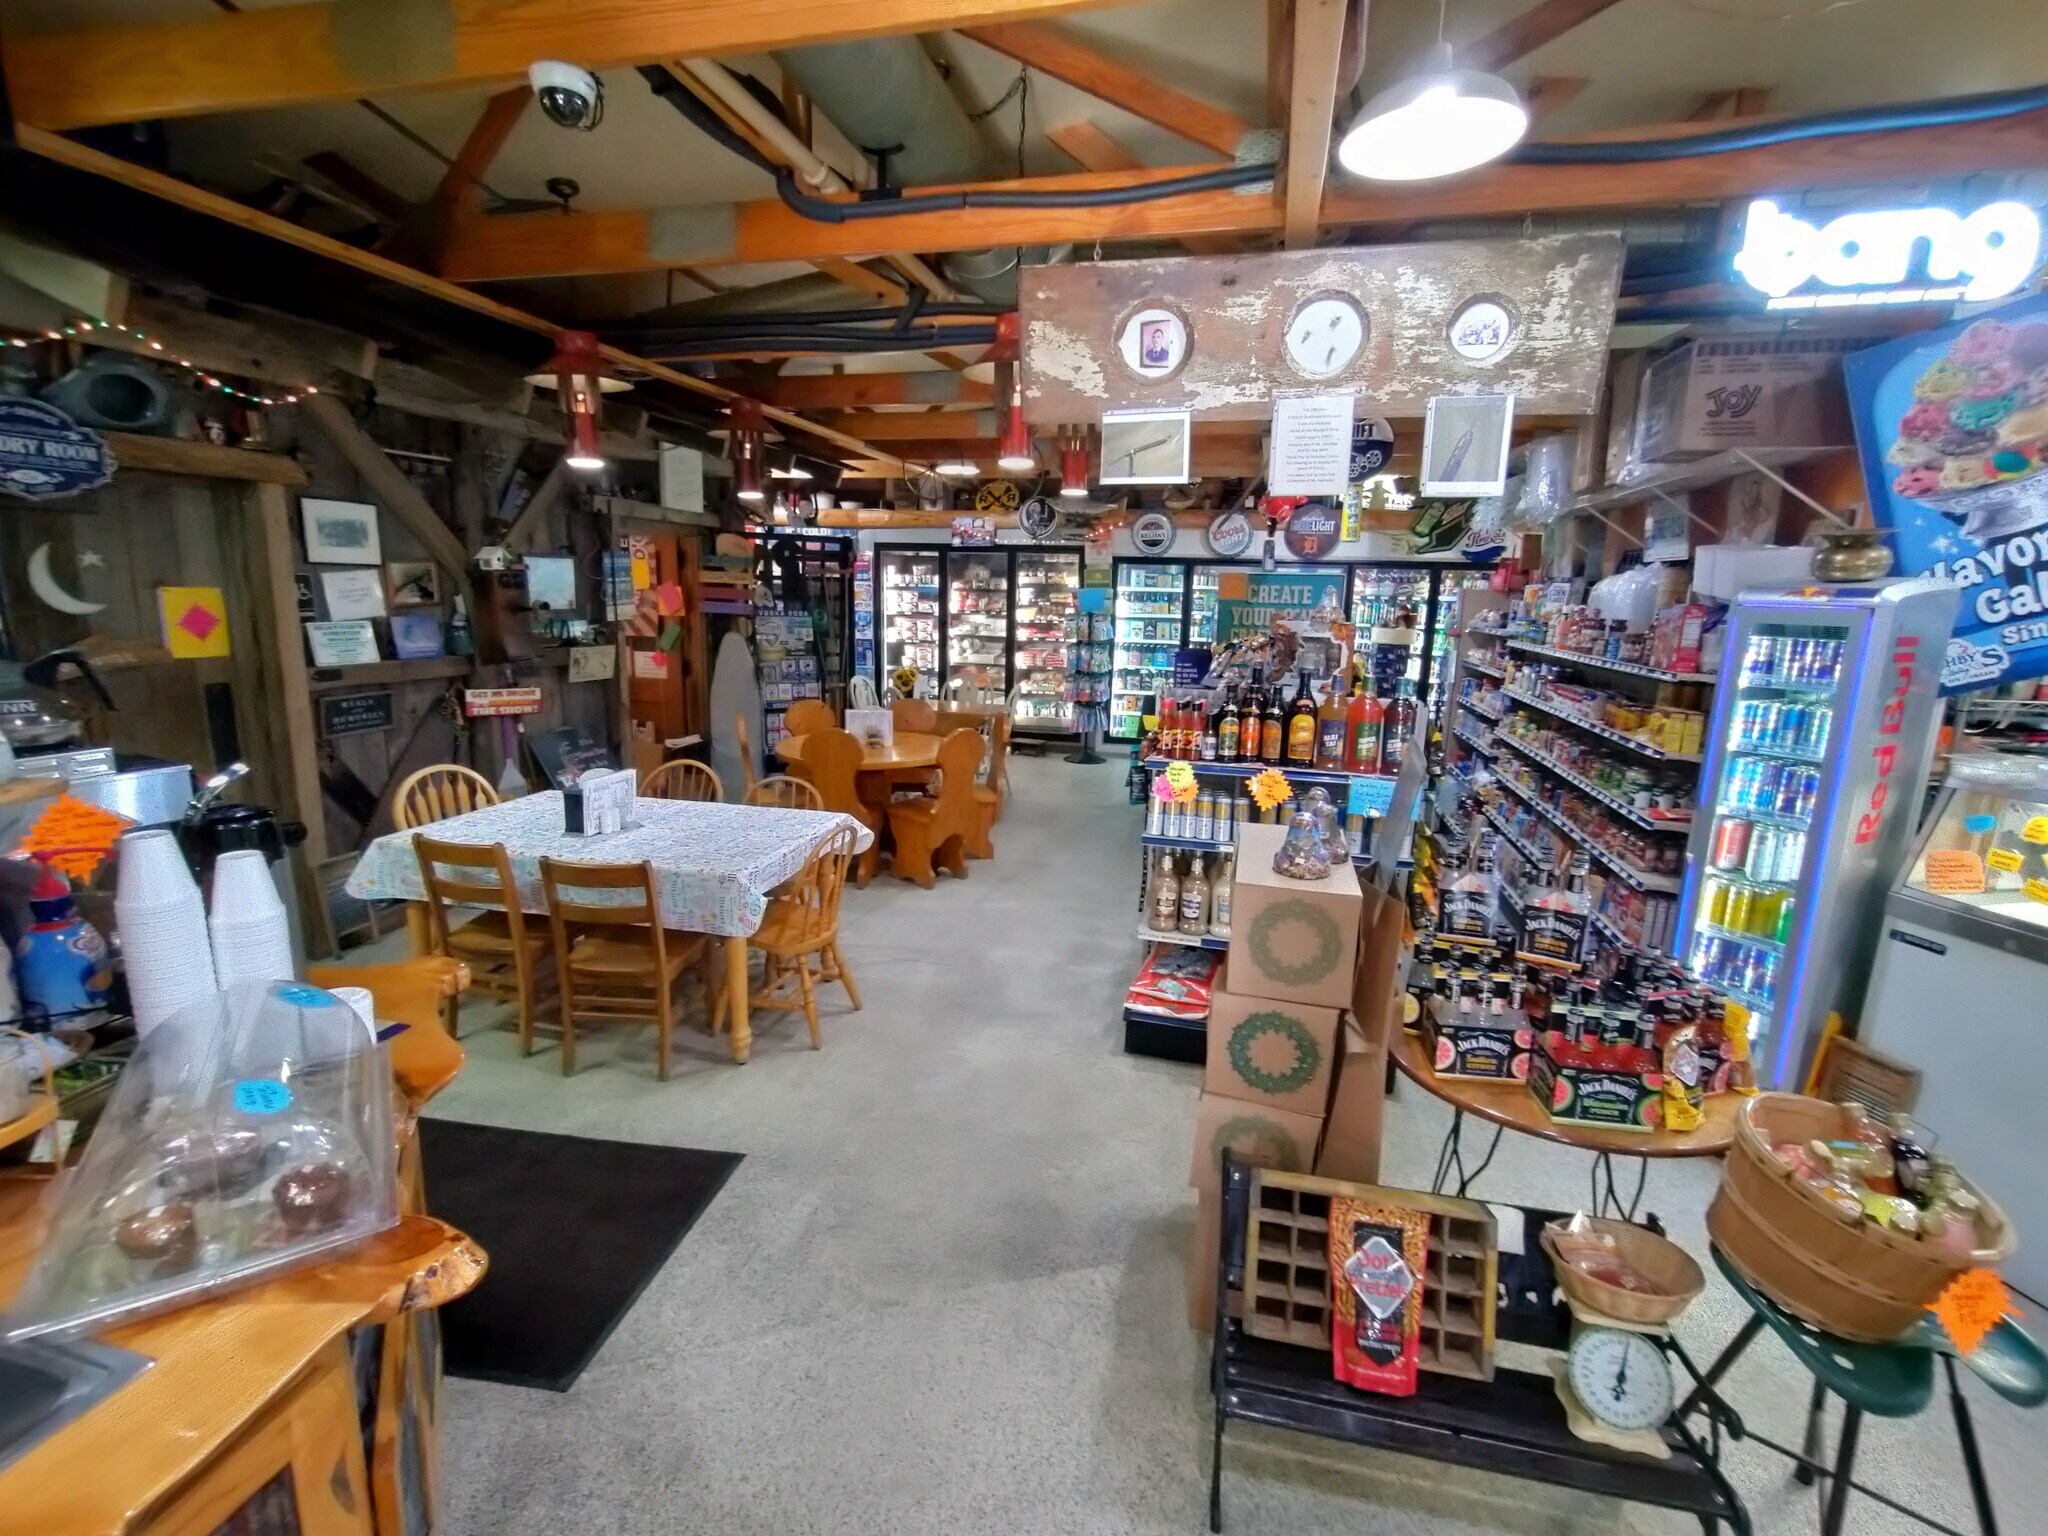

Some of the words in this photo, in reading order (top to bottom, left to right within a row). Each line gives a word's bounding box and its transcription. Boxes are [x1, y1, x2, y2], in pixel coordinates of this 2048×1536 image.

[1733, 199, 2041, 302] bang
[43, 440, 99, 461] ROOM
[1246, 584, 1313, 605] CREATE
[1855, 744, 1898, 844] Red
[1879, 636, 1920, 735] Bull
[1457, 1039, 1479, 1053] JACK
[1578, 1081, 1602, 1096] JACK
